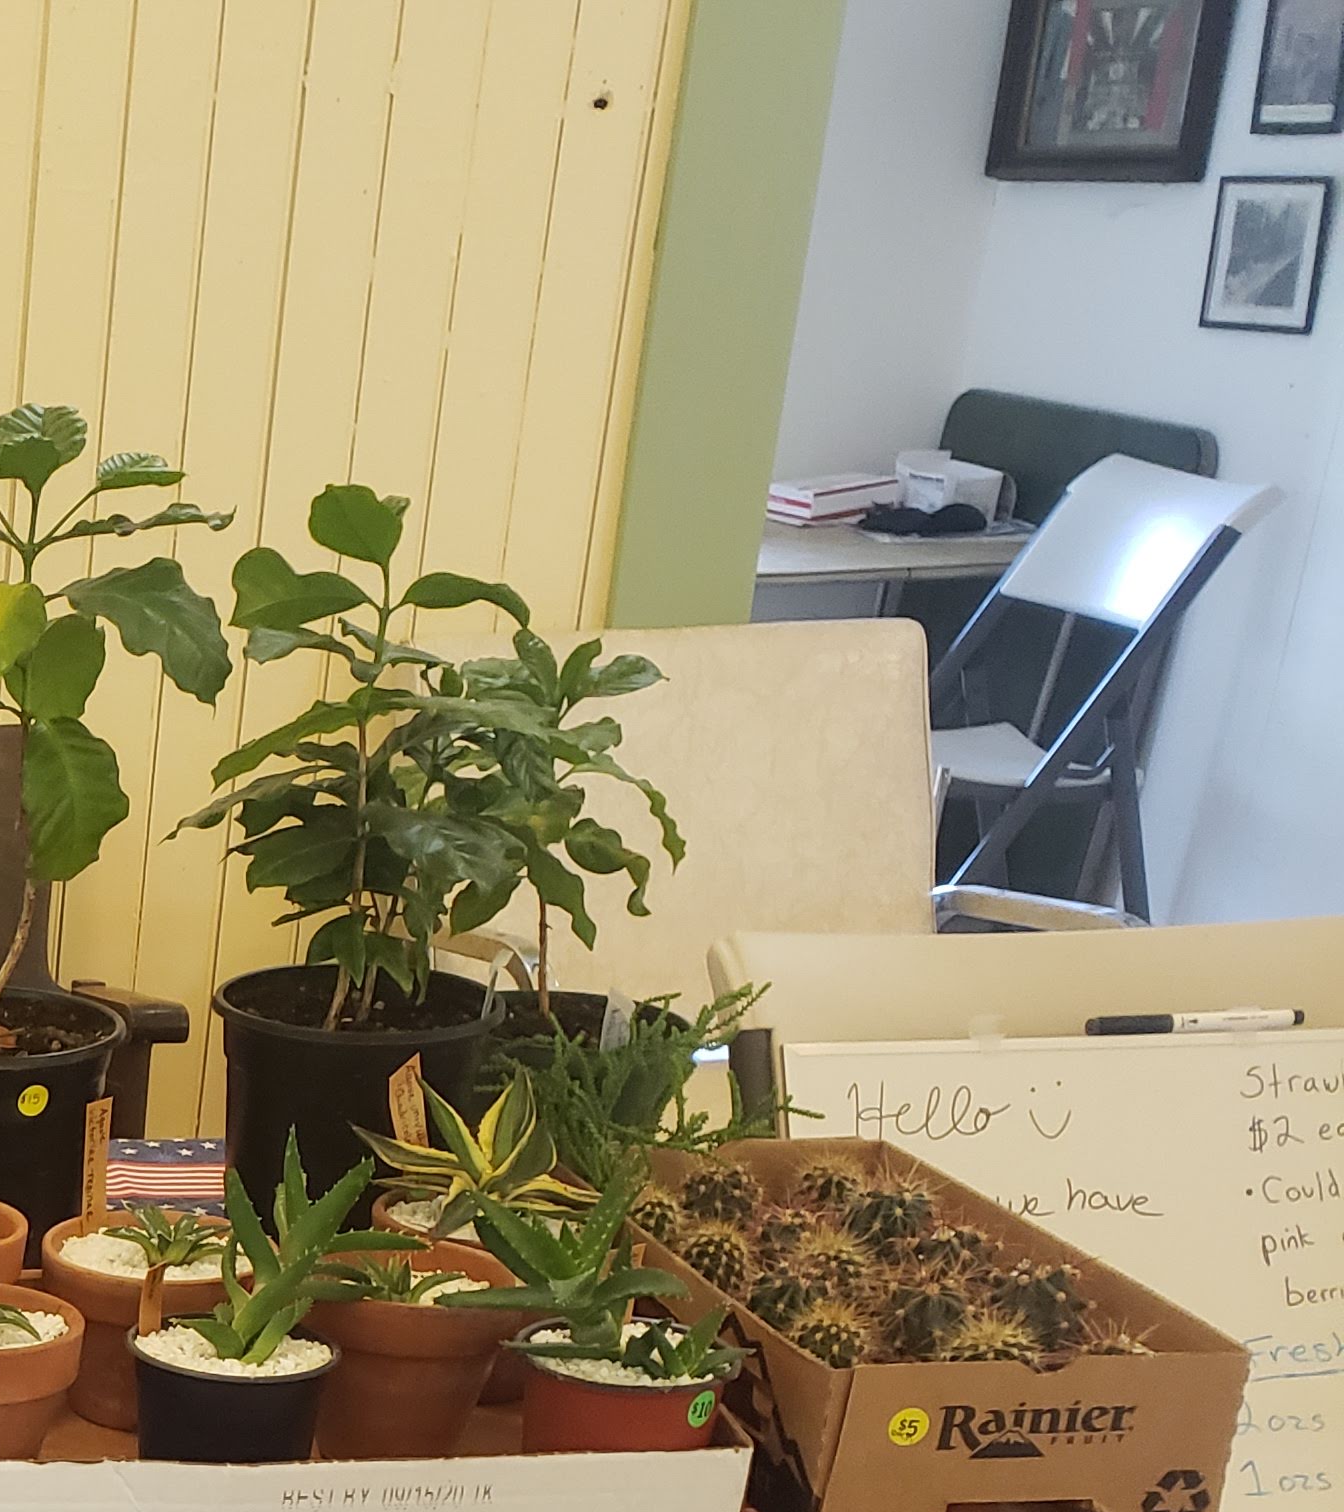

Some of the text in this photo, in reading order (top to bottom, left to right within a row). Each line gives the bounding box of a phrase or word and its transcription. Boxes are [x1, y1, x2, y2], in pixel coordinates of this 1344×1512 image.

[847, 1080, 1011, 1141] Hello
[1249, 1115, 1304, 1153] $2
[1067, 1177, 1165, 1217] have
[1262, 1168, 1340, 1204] Could
[1261, 1223, 1315, 1267] pink
[691, 1400, 713, 1419] $10
[898, 1418, 921, 1438] $5
[936, 1401, 1137, 1452] Rainier
[1268, 1413, 1326, 1432] ozs
[1050, 1432, 1126, 1446] FRUIT
[1240, 1460, 1333, 1497] 1 ozs
